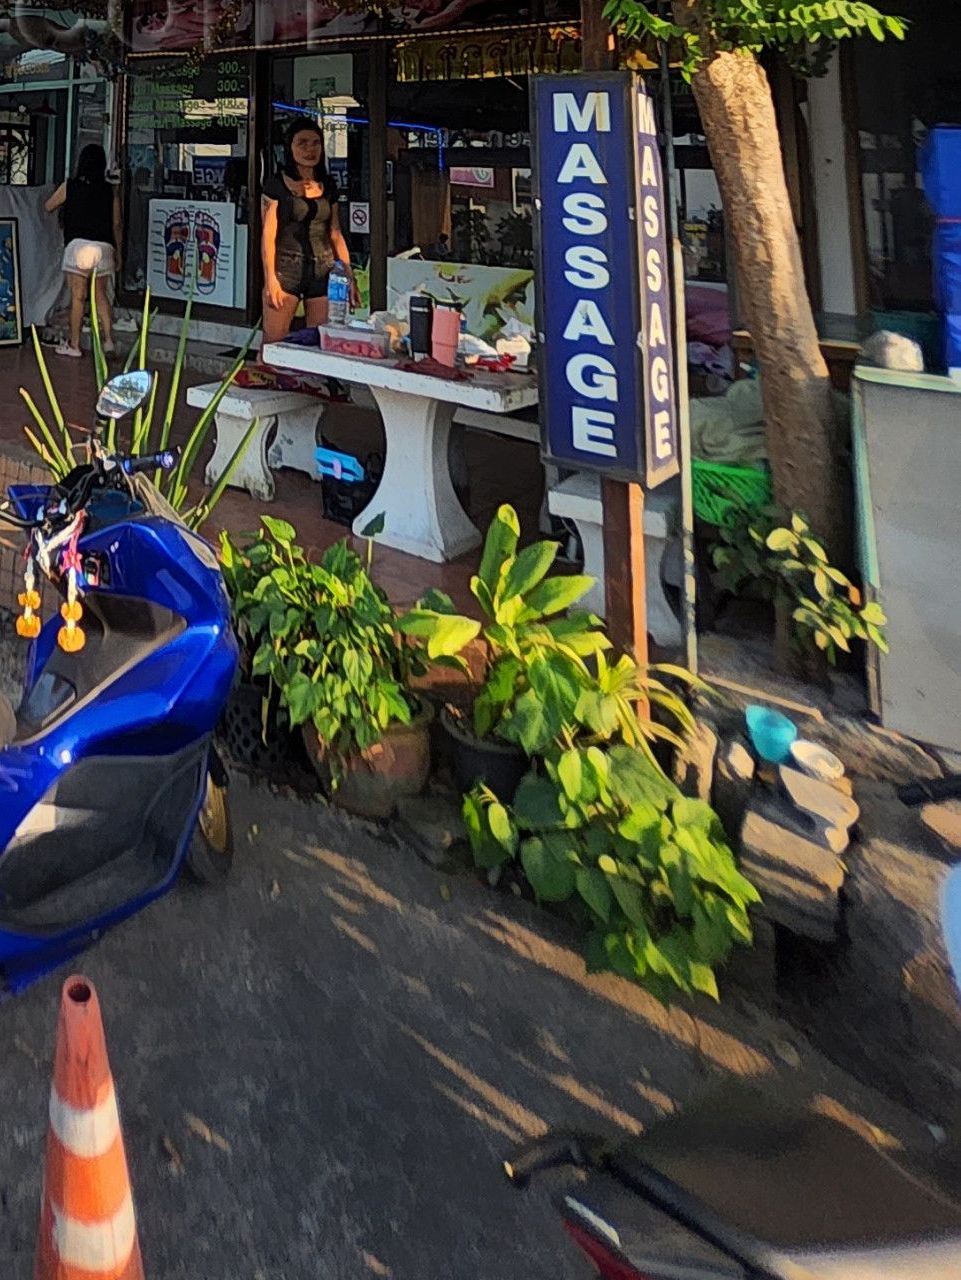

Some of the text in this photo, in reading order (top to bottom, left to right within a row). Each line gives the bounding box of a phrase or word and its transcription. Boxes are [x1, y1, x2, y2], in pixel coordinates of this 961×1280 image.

[217, 61, 246, 74] 300.-
[217, 79, 245, 93] 300.-
[552, 91, 619, 458] MASSAGE
[638, 87, 673, 460] MASSAGE
